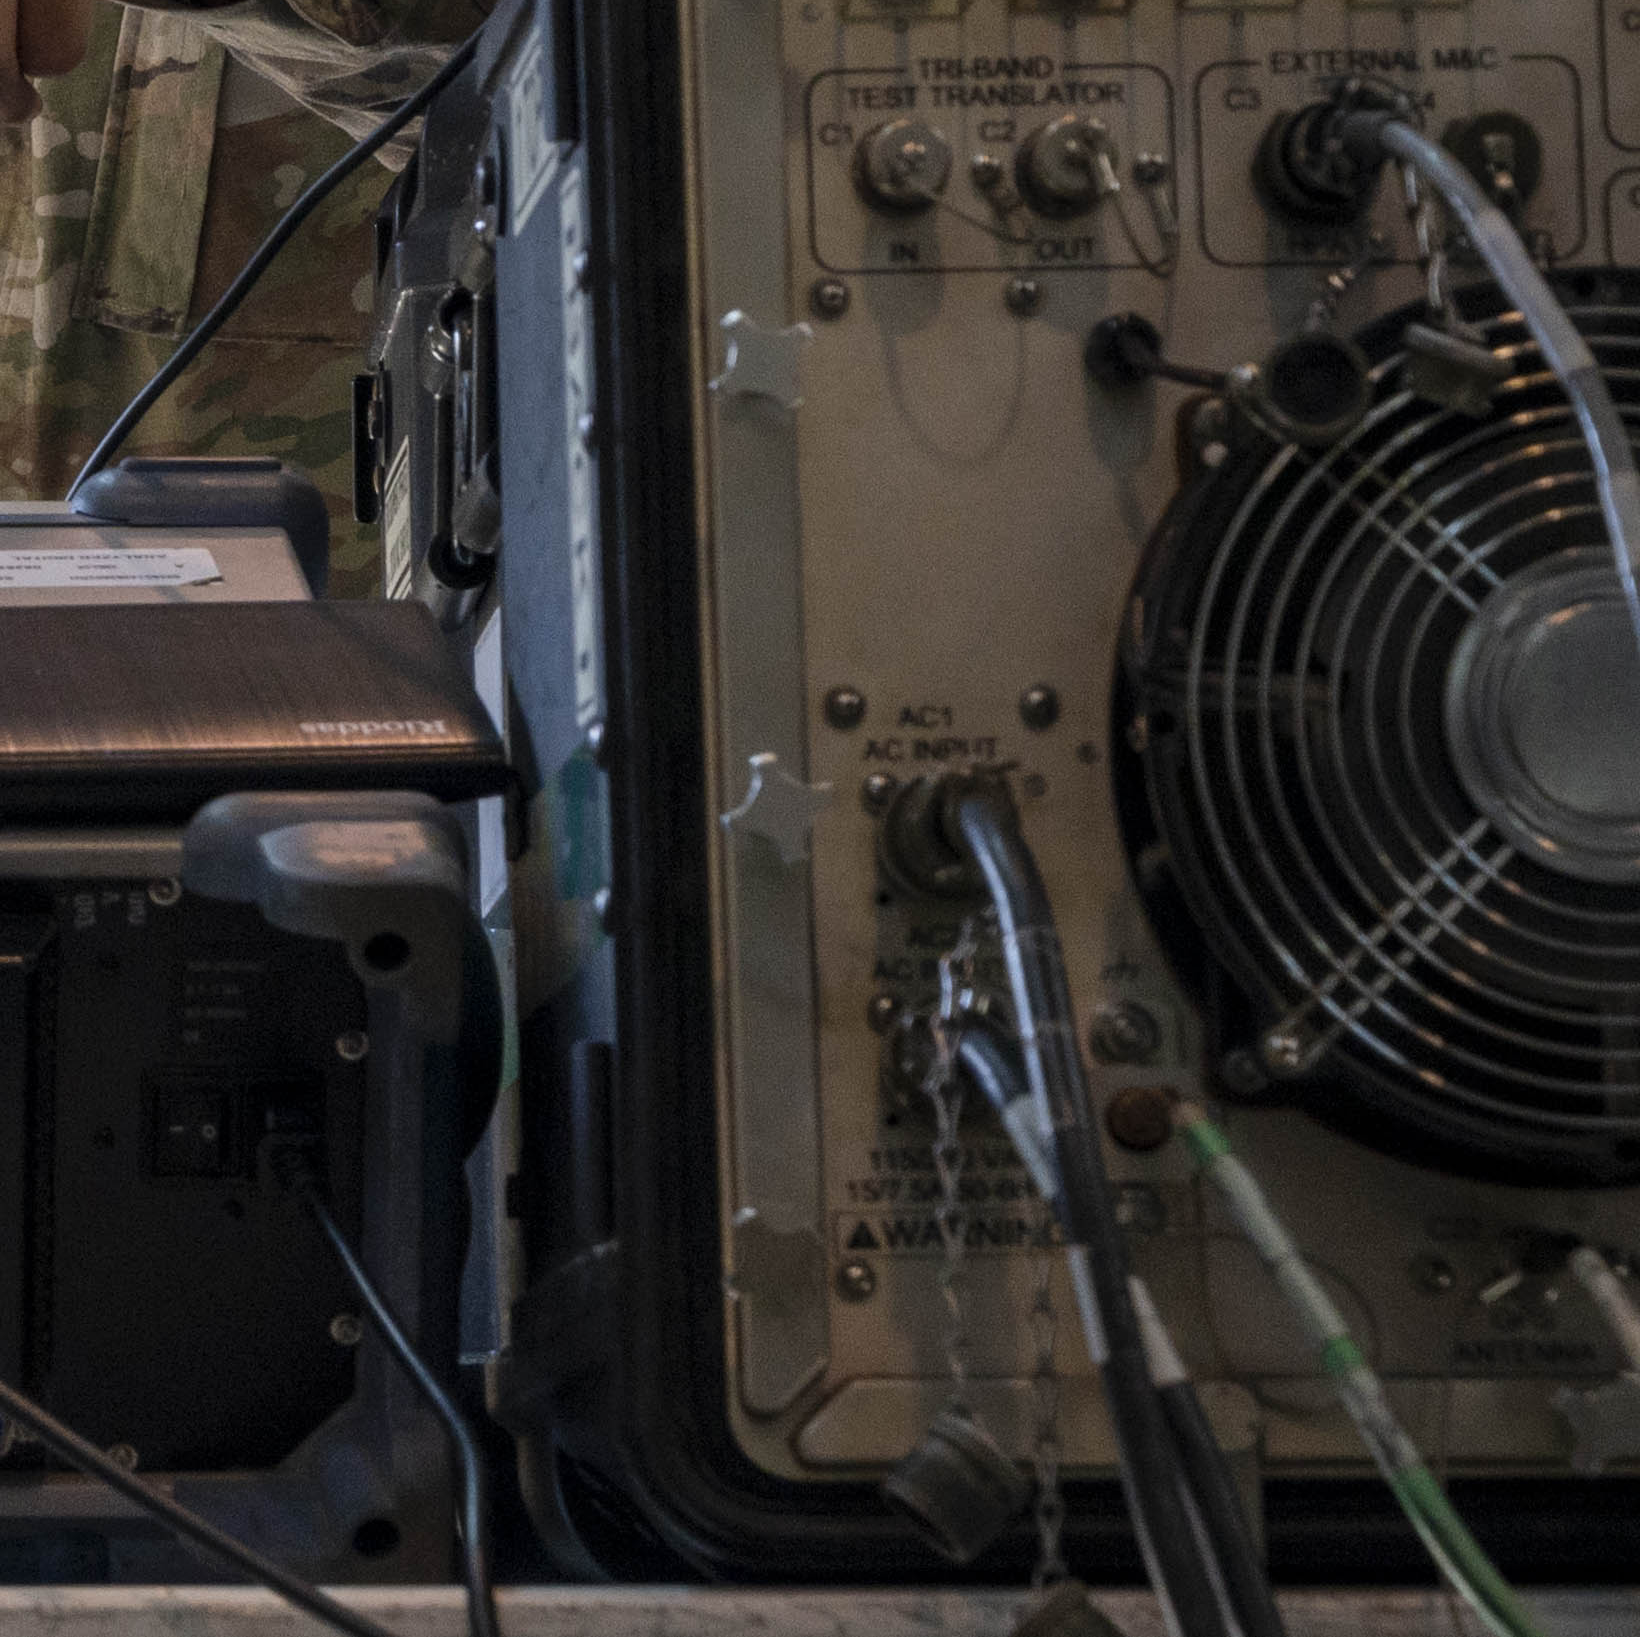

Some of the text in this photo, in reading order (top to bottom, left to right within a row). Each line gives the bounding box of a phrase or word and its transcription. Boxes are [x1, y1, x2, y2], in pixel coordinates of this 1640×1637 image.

[919, 57, 1054, 79] TRI-BAND
[1270, 46, 1499, 74] EXTERNAL M&C
[848, 83, 1125, 108] TEST TRANSLATOR
[1225, 87, 1261, 110] C3
[980, 120, 1016, 142] C2
[889, 242, 918, 262] IN
[1035, 237, 1094, 261] OUT
[299, 719, 447, 735] Rioddas
[898, 706, 952, 728] AC1
[864, 738, 904, 761] AC
